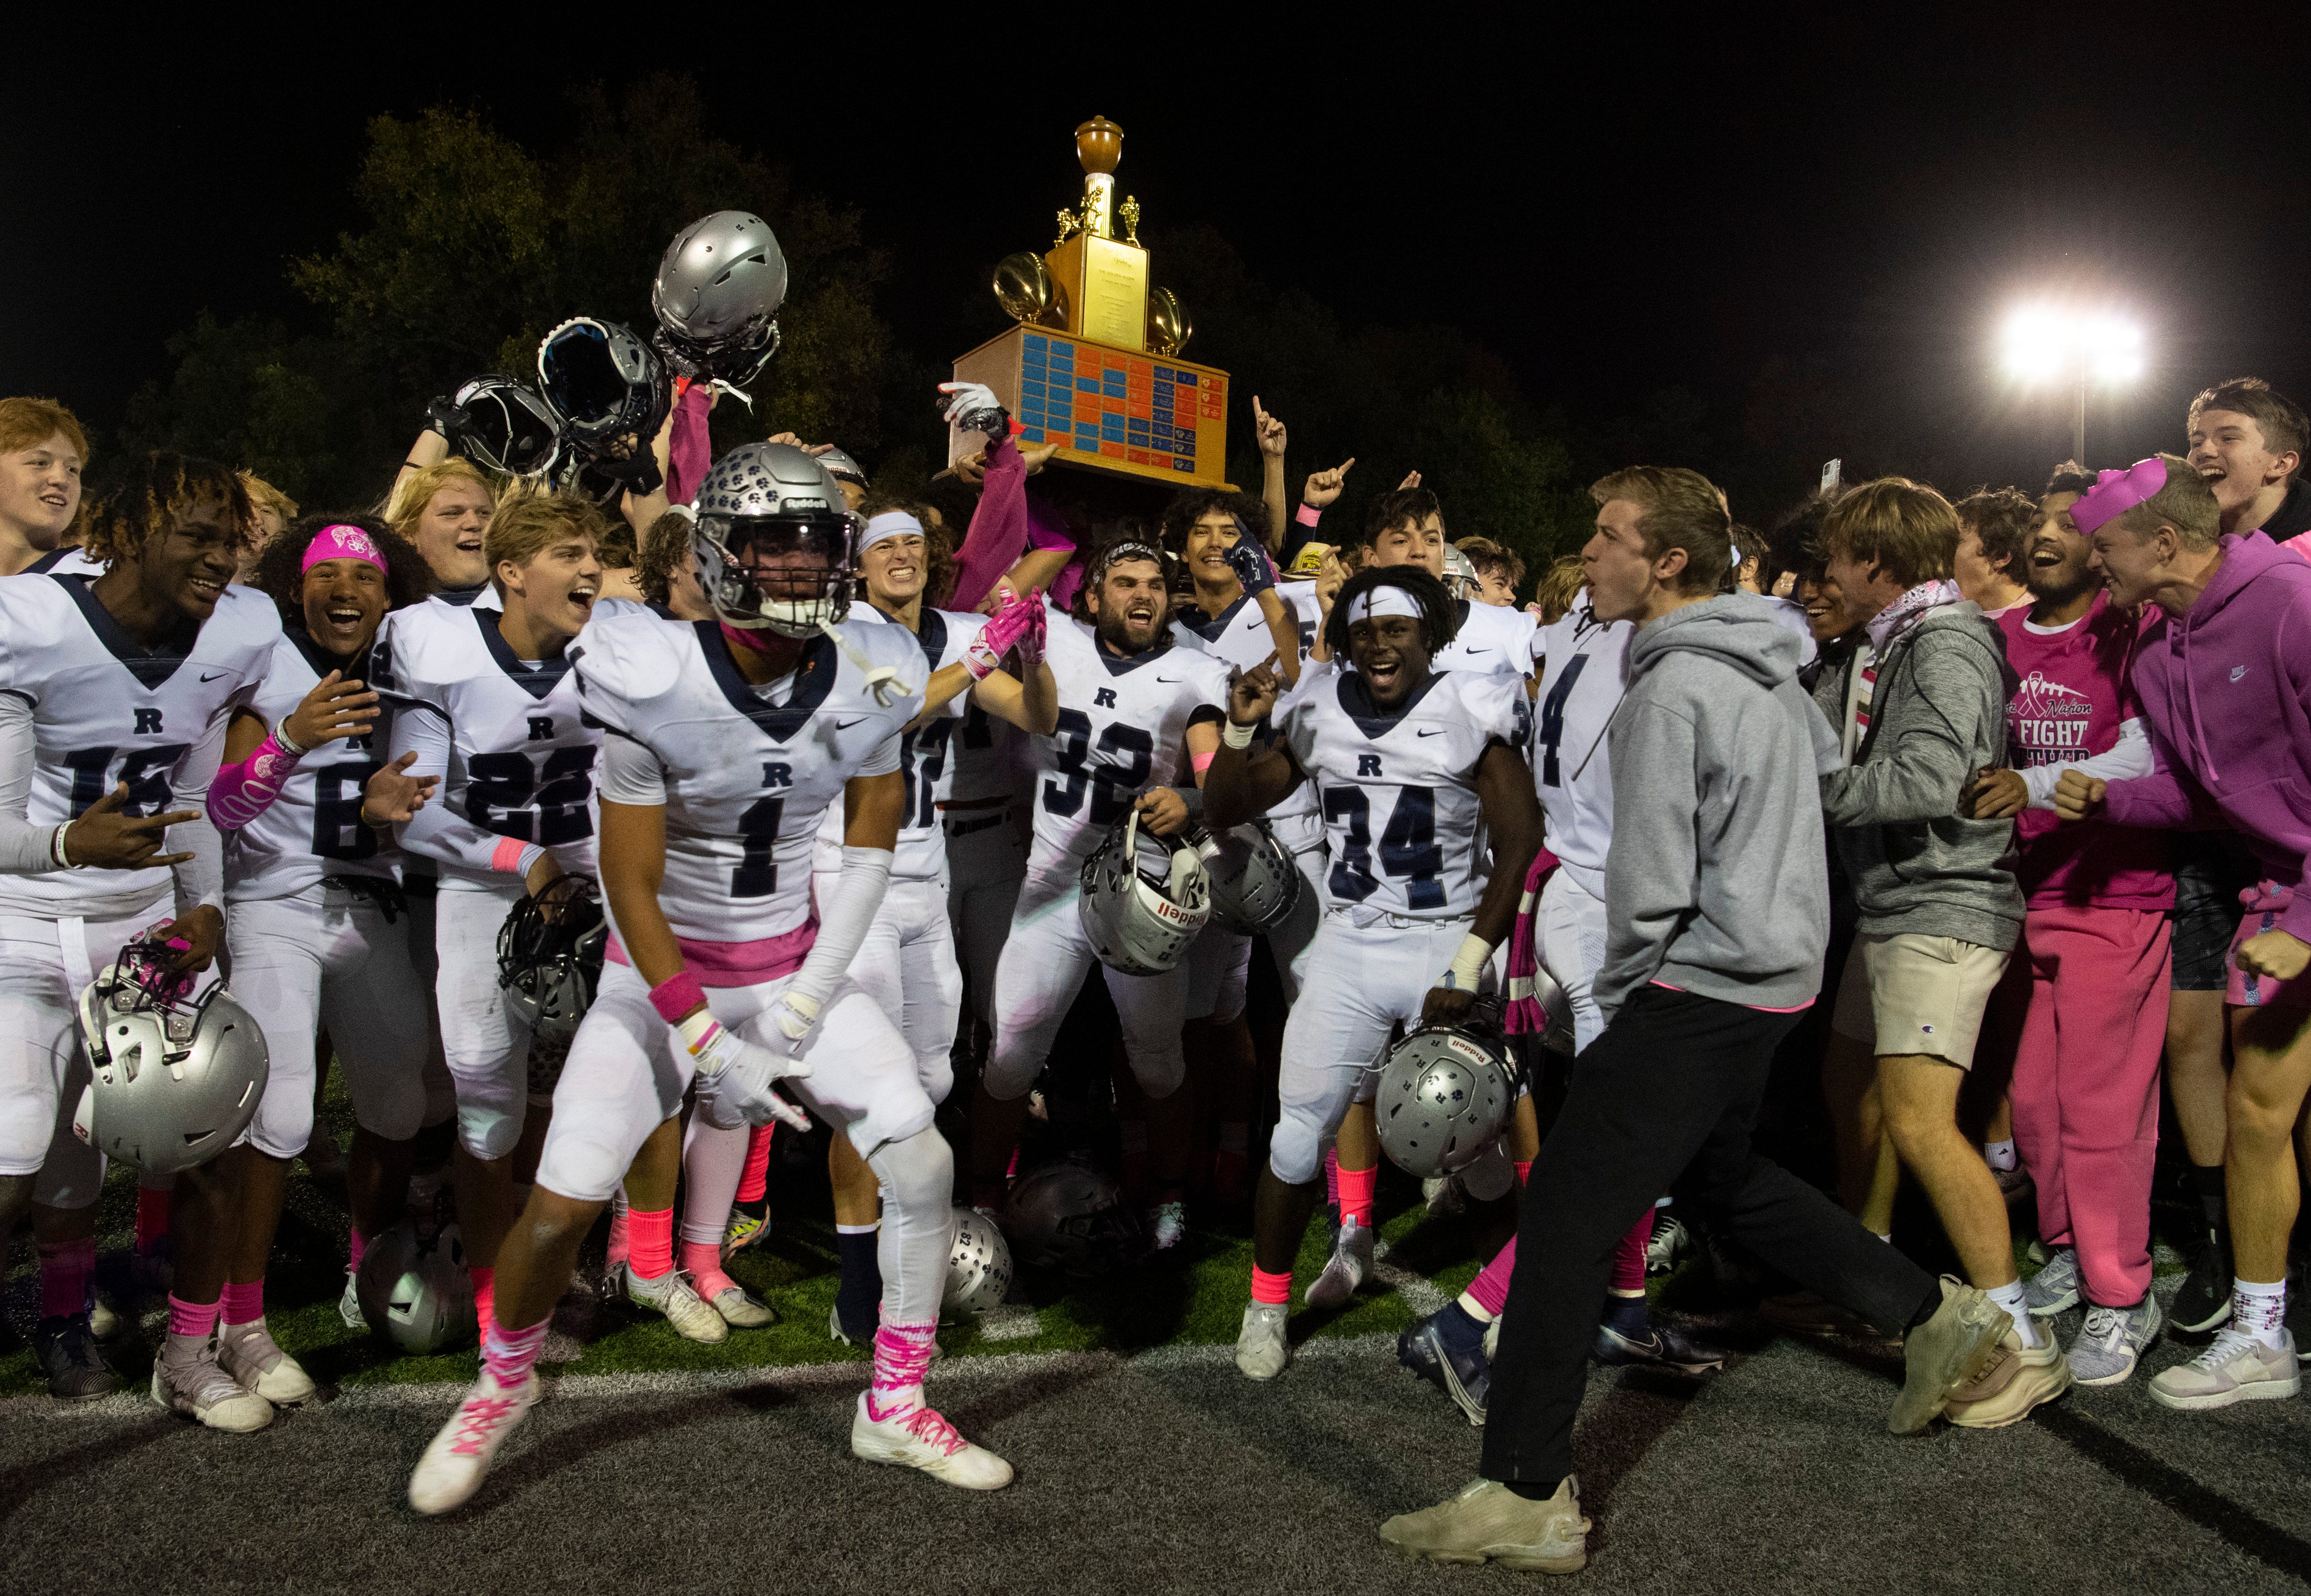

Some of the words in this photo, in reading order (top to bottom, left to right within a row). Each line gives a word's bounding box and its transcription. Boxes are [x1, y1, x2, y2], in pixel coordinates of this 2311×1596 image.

[786, 498, 827, 508] Riddell
[1093, 687, 1117, 709] R
[2045, 698, 2092, 718] Nation
[133, 708, 163, 734] R
[527, 717, 554, 741] R
[2020, 719, 2089, 746] FIGHT
[762, 763, 793, 788] R
[1042, 706, 1153, 826] 32
[1357, 754, 1383, 776] R
[465, 744, 598, 846] 22
[731, 797, 785, 898] 1
[1324, 785, 1448, 910] 34
[1452, 1040, 1486, 1063] Riddell
[959, 1232, 972, 1246] 82
